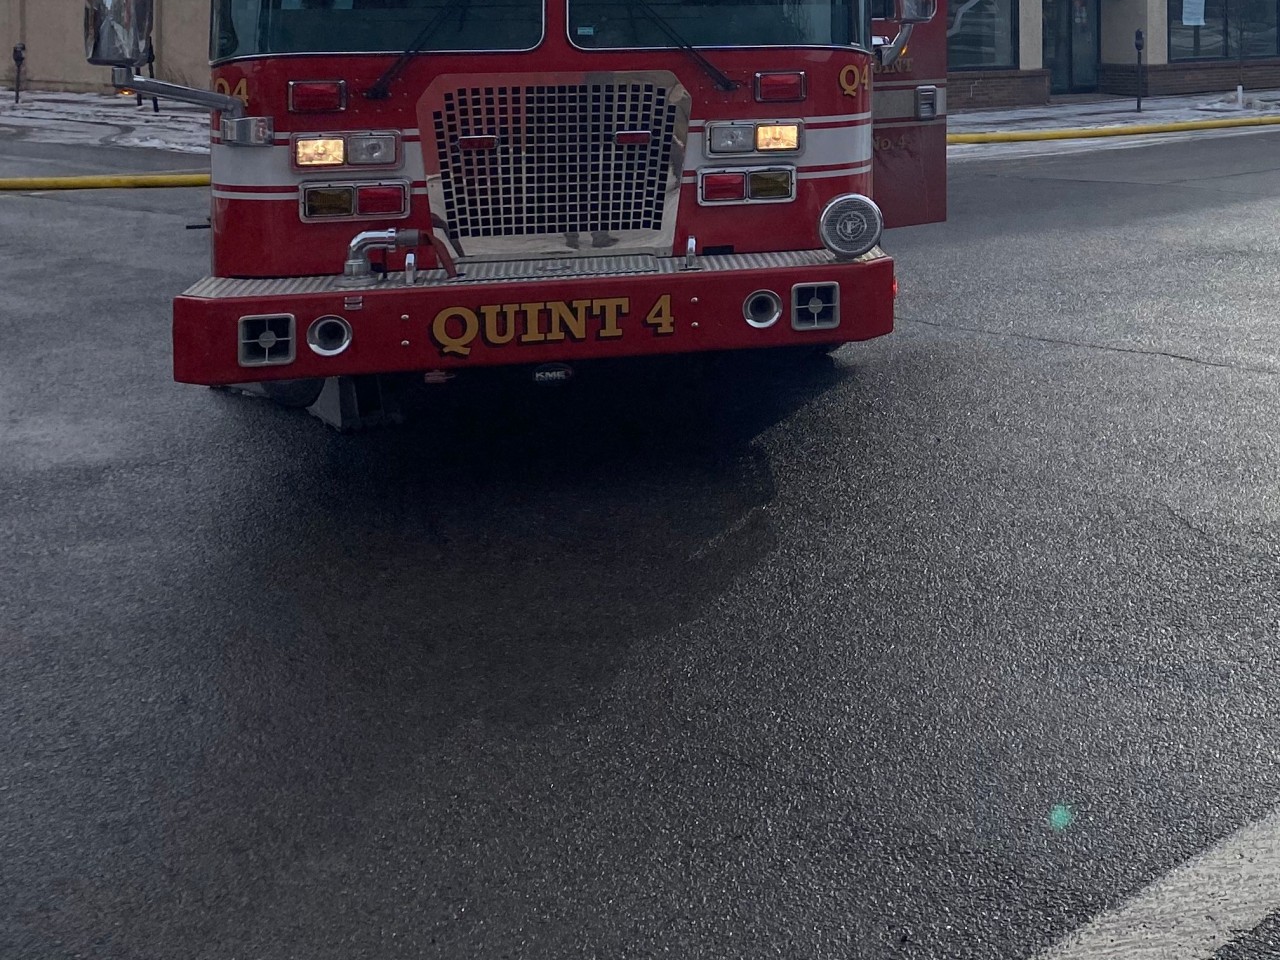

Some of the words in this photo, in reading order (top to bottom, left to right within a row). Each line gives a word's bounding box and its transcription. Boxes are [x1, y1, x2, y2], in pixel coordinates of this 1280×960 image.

[839, 64, 869, 97] Q4
[432, 297, 630, 356] QUINT
[646, 294, 674, 334] 4
[535, 370, 566, 381] KME
